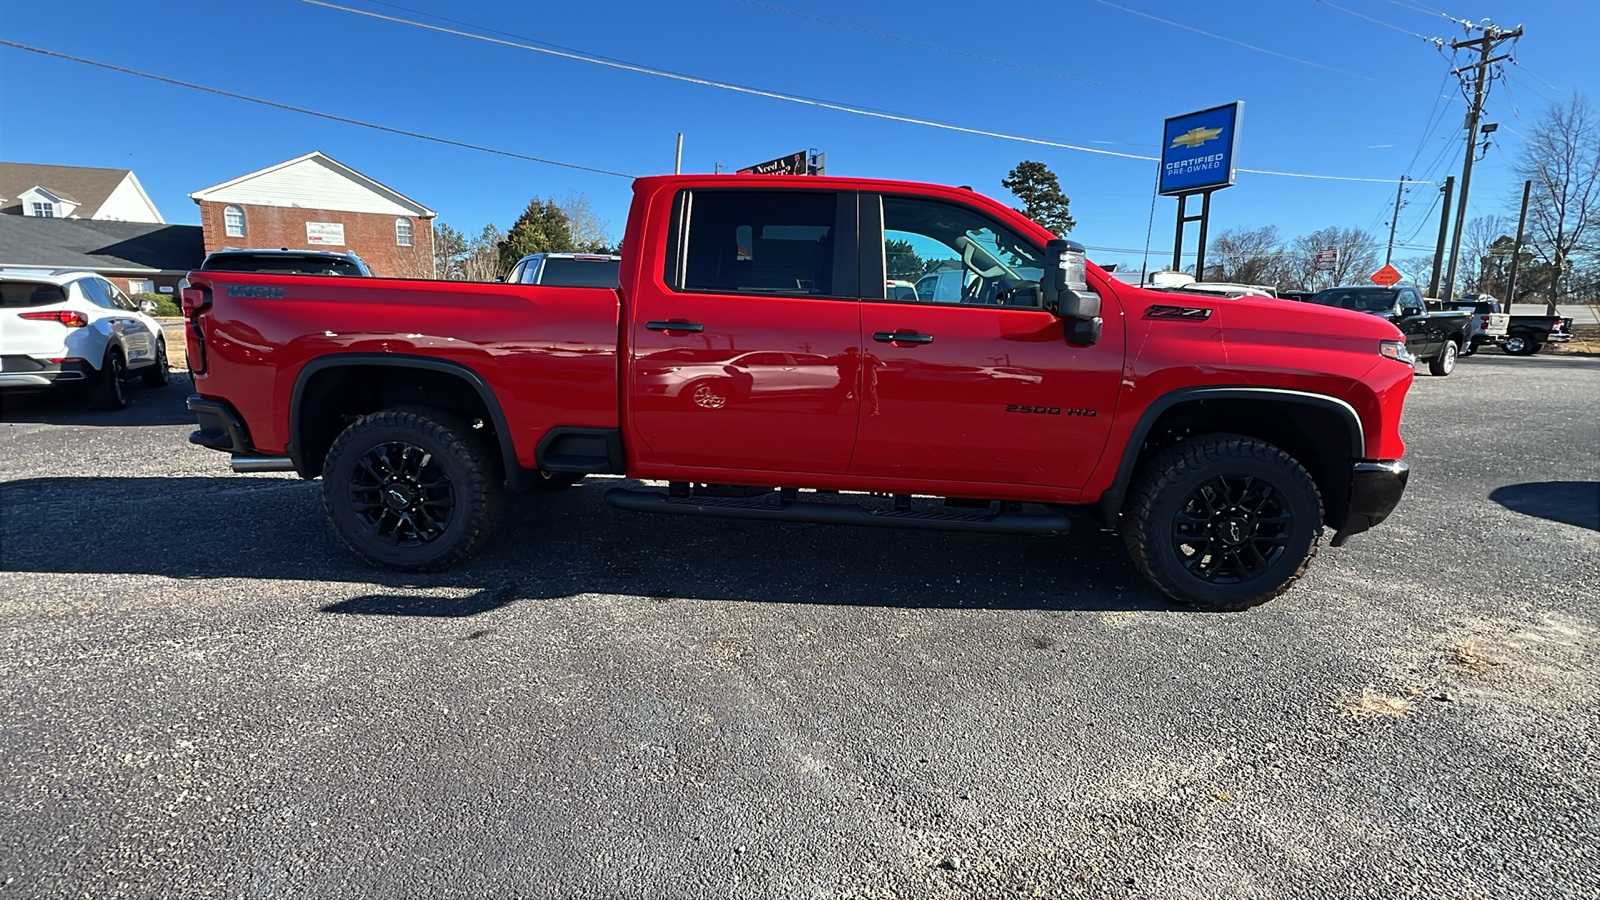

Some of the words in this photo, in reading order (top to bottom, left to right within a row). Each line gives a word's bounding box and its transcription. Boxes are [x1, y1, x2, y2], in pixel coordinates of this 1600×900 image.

[757, 161, 778, 173] Need
[1166, 153, 1223, 170] CERTIFIED
[1167, 161, 1220, 176] PRE-OWNED
[1147, 304, 1213, 320] Z71
[1006, 404, 1061, 415] 2500
[1067, 408, 1097, 417] HD
